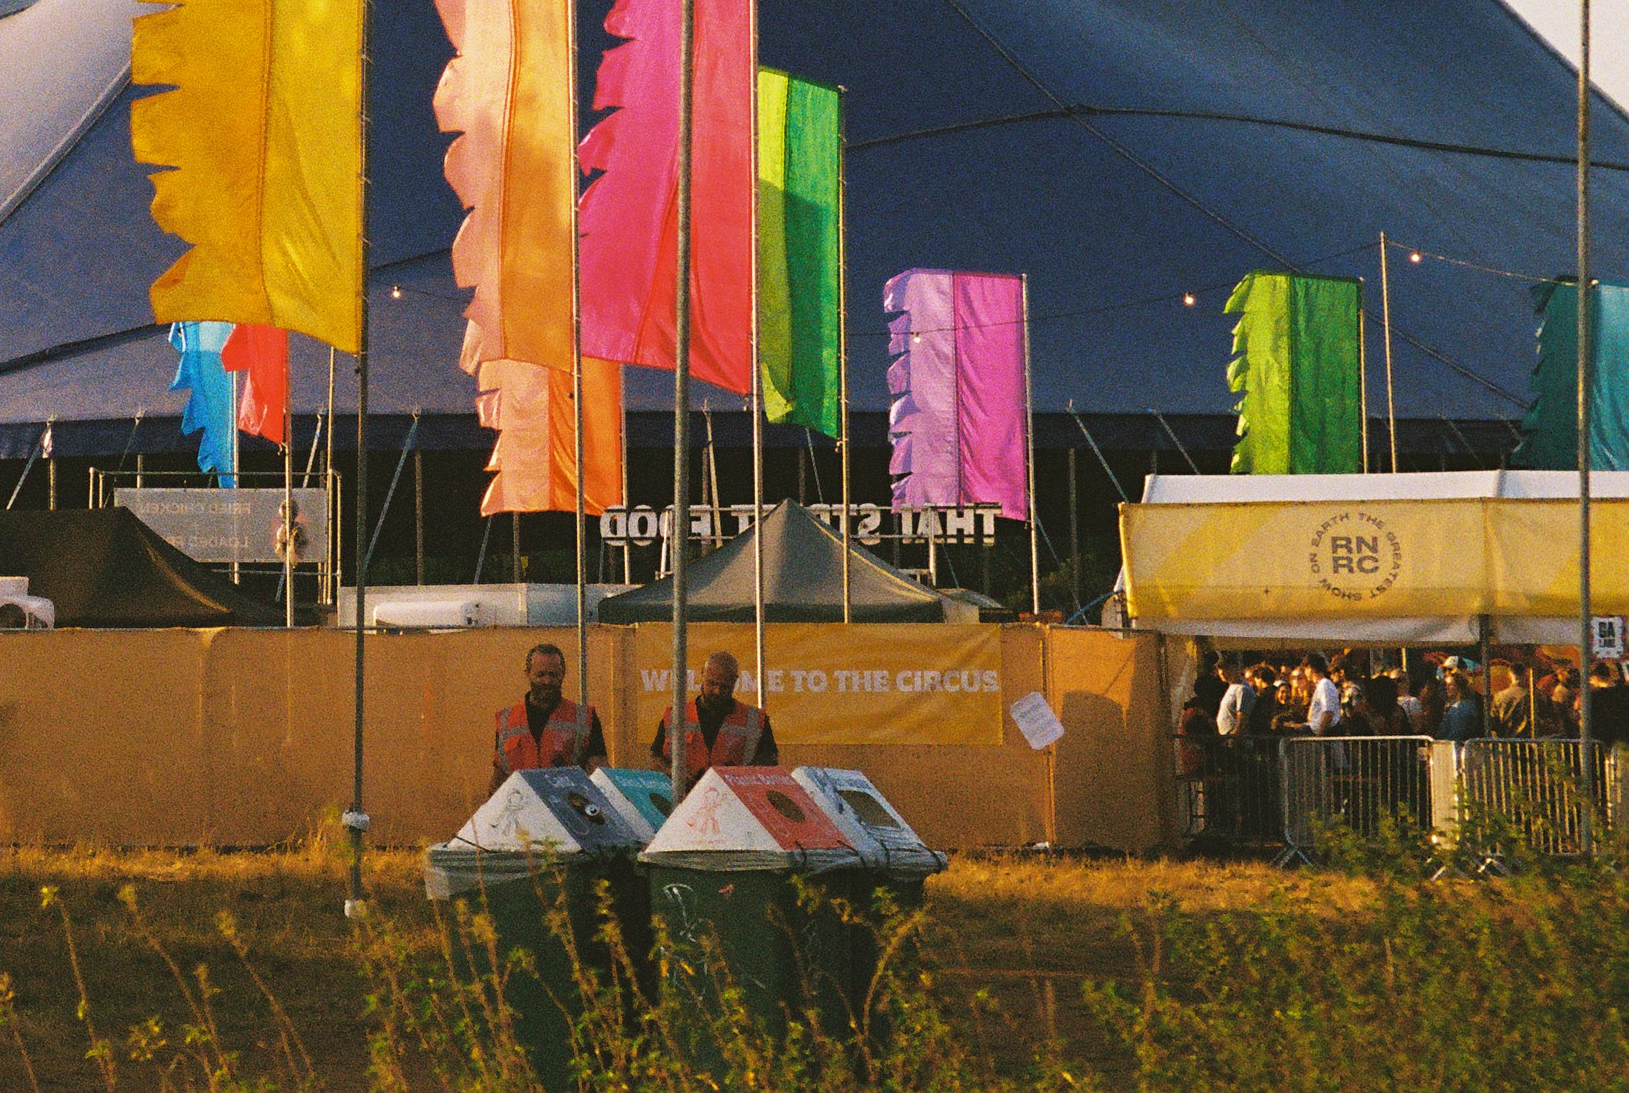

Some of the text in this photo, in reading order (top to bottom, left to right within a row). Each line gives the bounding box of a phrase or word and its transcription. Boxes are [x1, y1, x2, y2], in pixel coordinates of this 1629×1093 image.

[1331, 535, 1379, 555] RN
[1308, 512, 1403, 602] THE GREATEST SHOW ON EARTH
[1332, 555, 1380, 574] RC
[640, 669, 1001, 694] WLME TO THE CIRCUS
